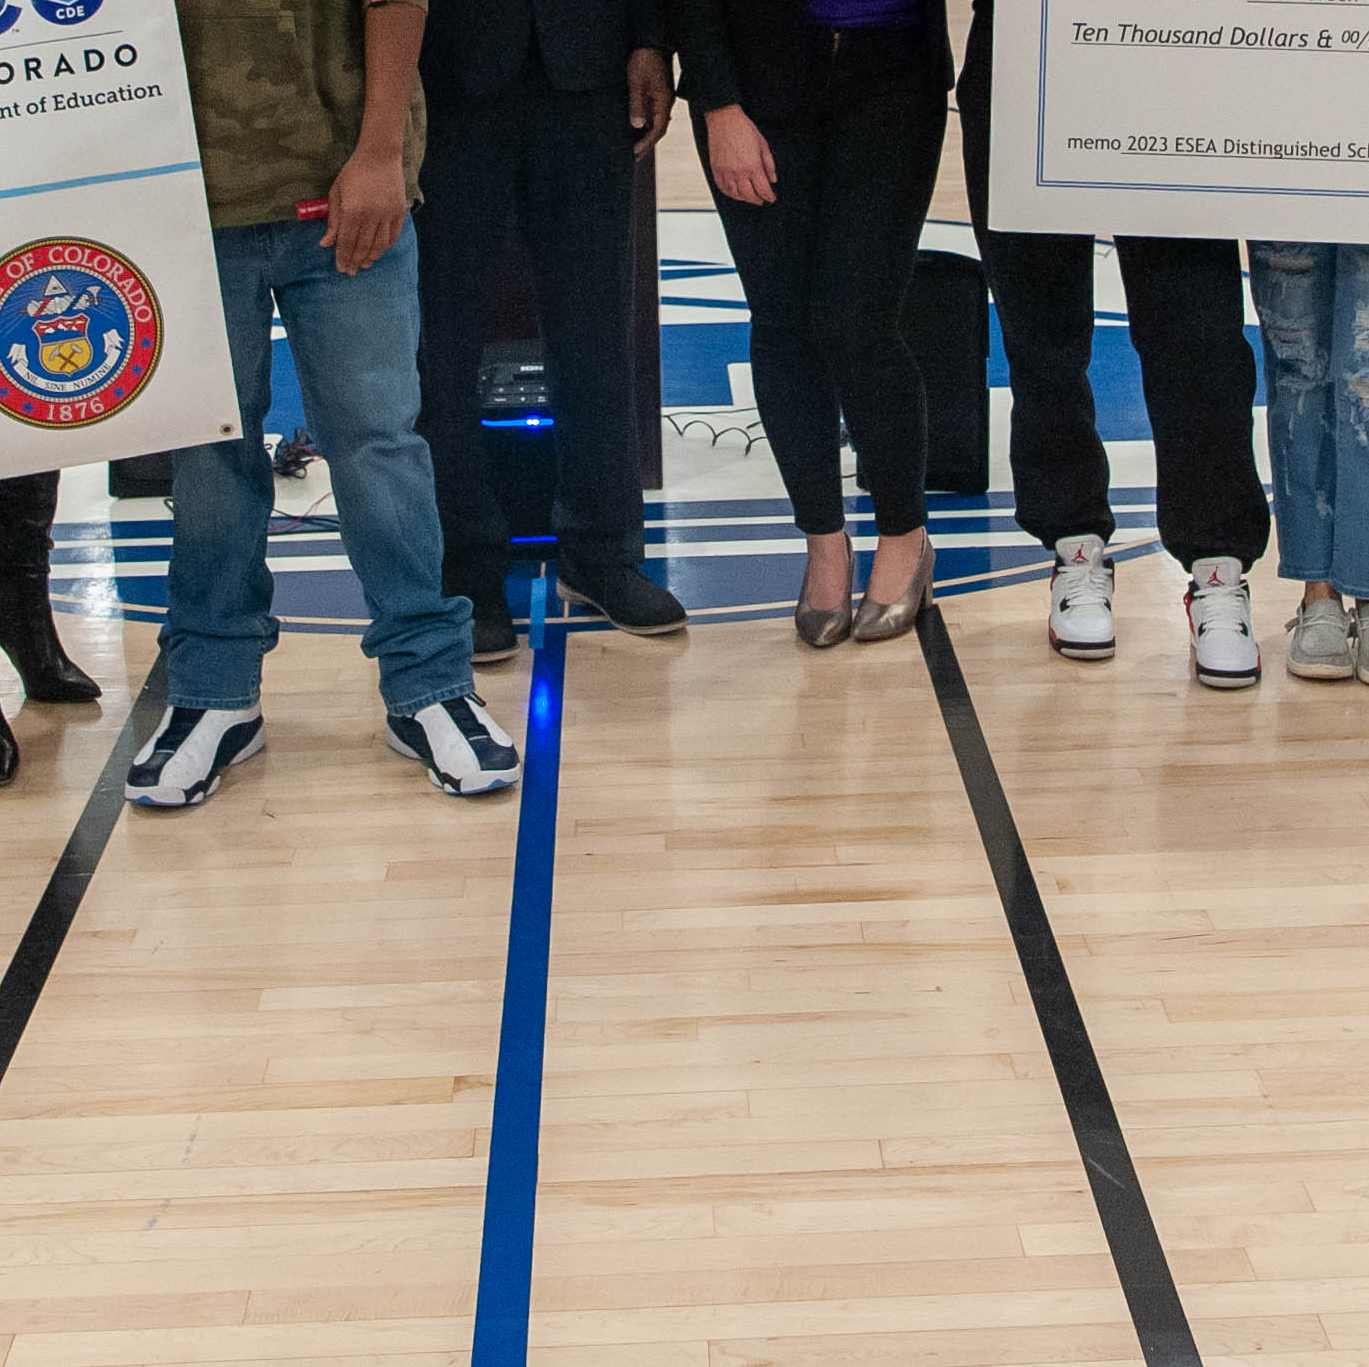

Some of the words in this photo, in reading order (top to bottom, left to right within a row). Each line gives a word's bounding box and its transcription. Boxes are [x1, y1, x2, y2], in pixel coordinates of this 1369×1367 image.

[55, 5, 86, 20] CDE
[1072, 22, 1109, 43] Ten
[1118, 23, 1224, 46] Thousand
[1230, 26, 1309, 48] Dollars
[1316, 29, 1333, 49] &
[26, 97, 48, 116] of
[53, 81, 164, 112] Education
[1067, 136, 1121, 151] memo
[1127, 135, 1169, 152] 2023
[1174, 137, 1218, 154] ESEA
[1223, 138, 1341, 159] Distinguished
[5, 253, 37, 280] OF
[47, 246, 154, 324] COLORADO
[45, 381, 68, 392] SINE
[73, 362, 112, 390] NUMINE
[47, 397, 106, 422] 1876
